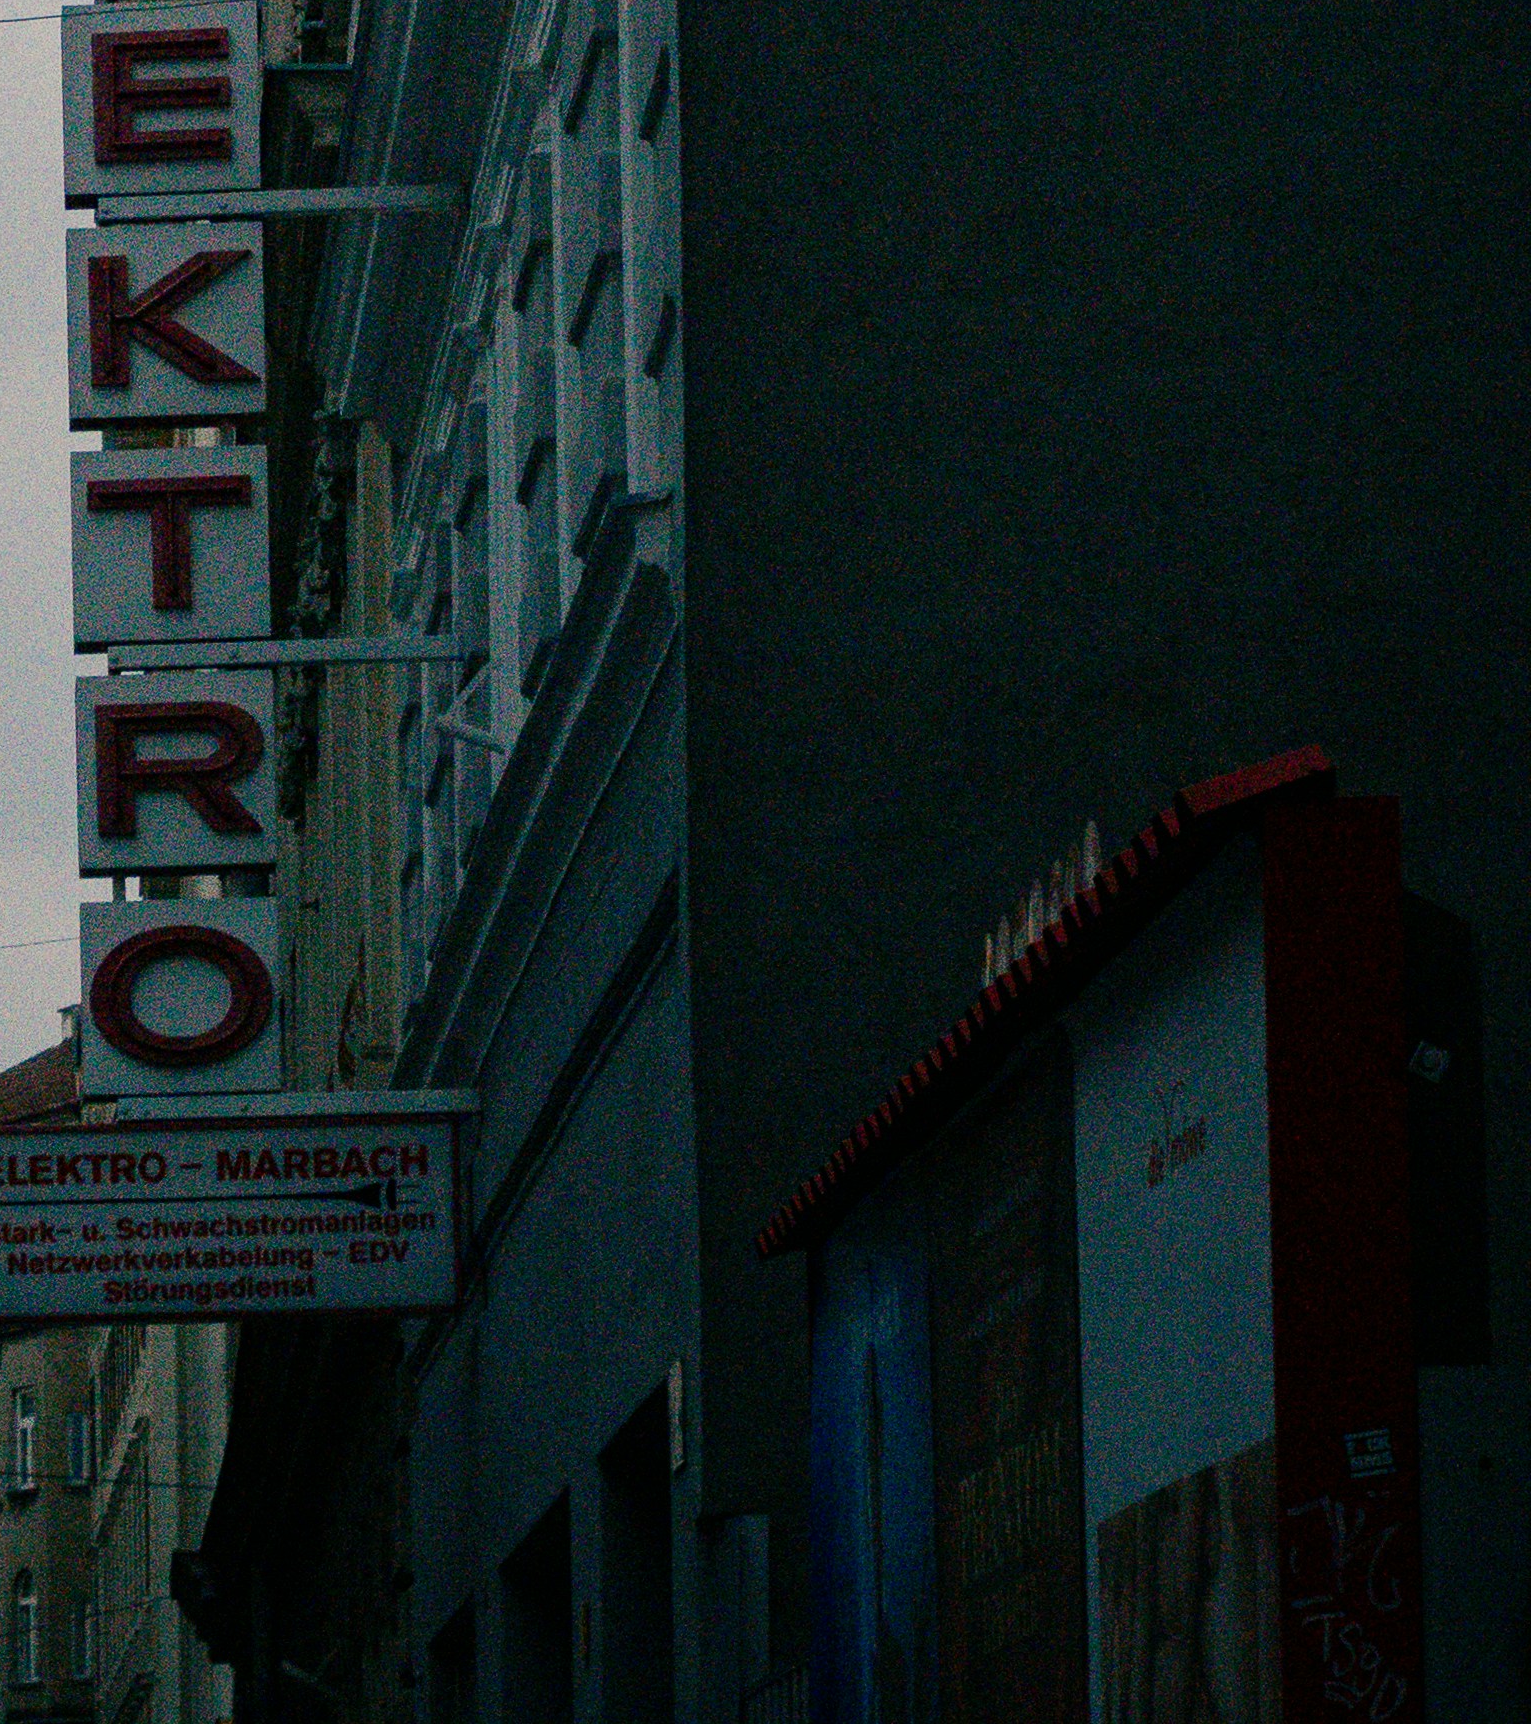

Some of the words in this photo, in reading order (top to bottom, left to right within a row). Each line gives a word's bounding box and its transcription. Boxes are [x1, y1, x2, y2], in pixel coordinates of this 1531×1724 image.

[216, 1144, 429, 1182] MARBACH
[81, 1225, 107, 1243] u.
[115, 1211, 437, 1241] Schwachstromanlagen
[8, 1243, 314, 1275] Netzwerkverkabelung
[349, 1240, 409, 1265] EDV
[103, 1277, 316, 1306] Störungsdienst
